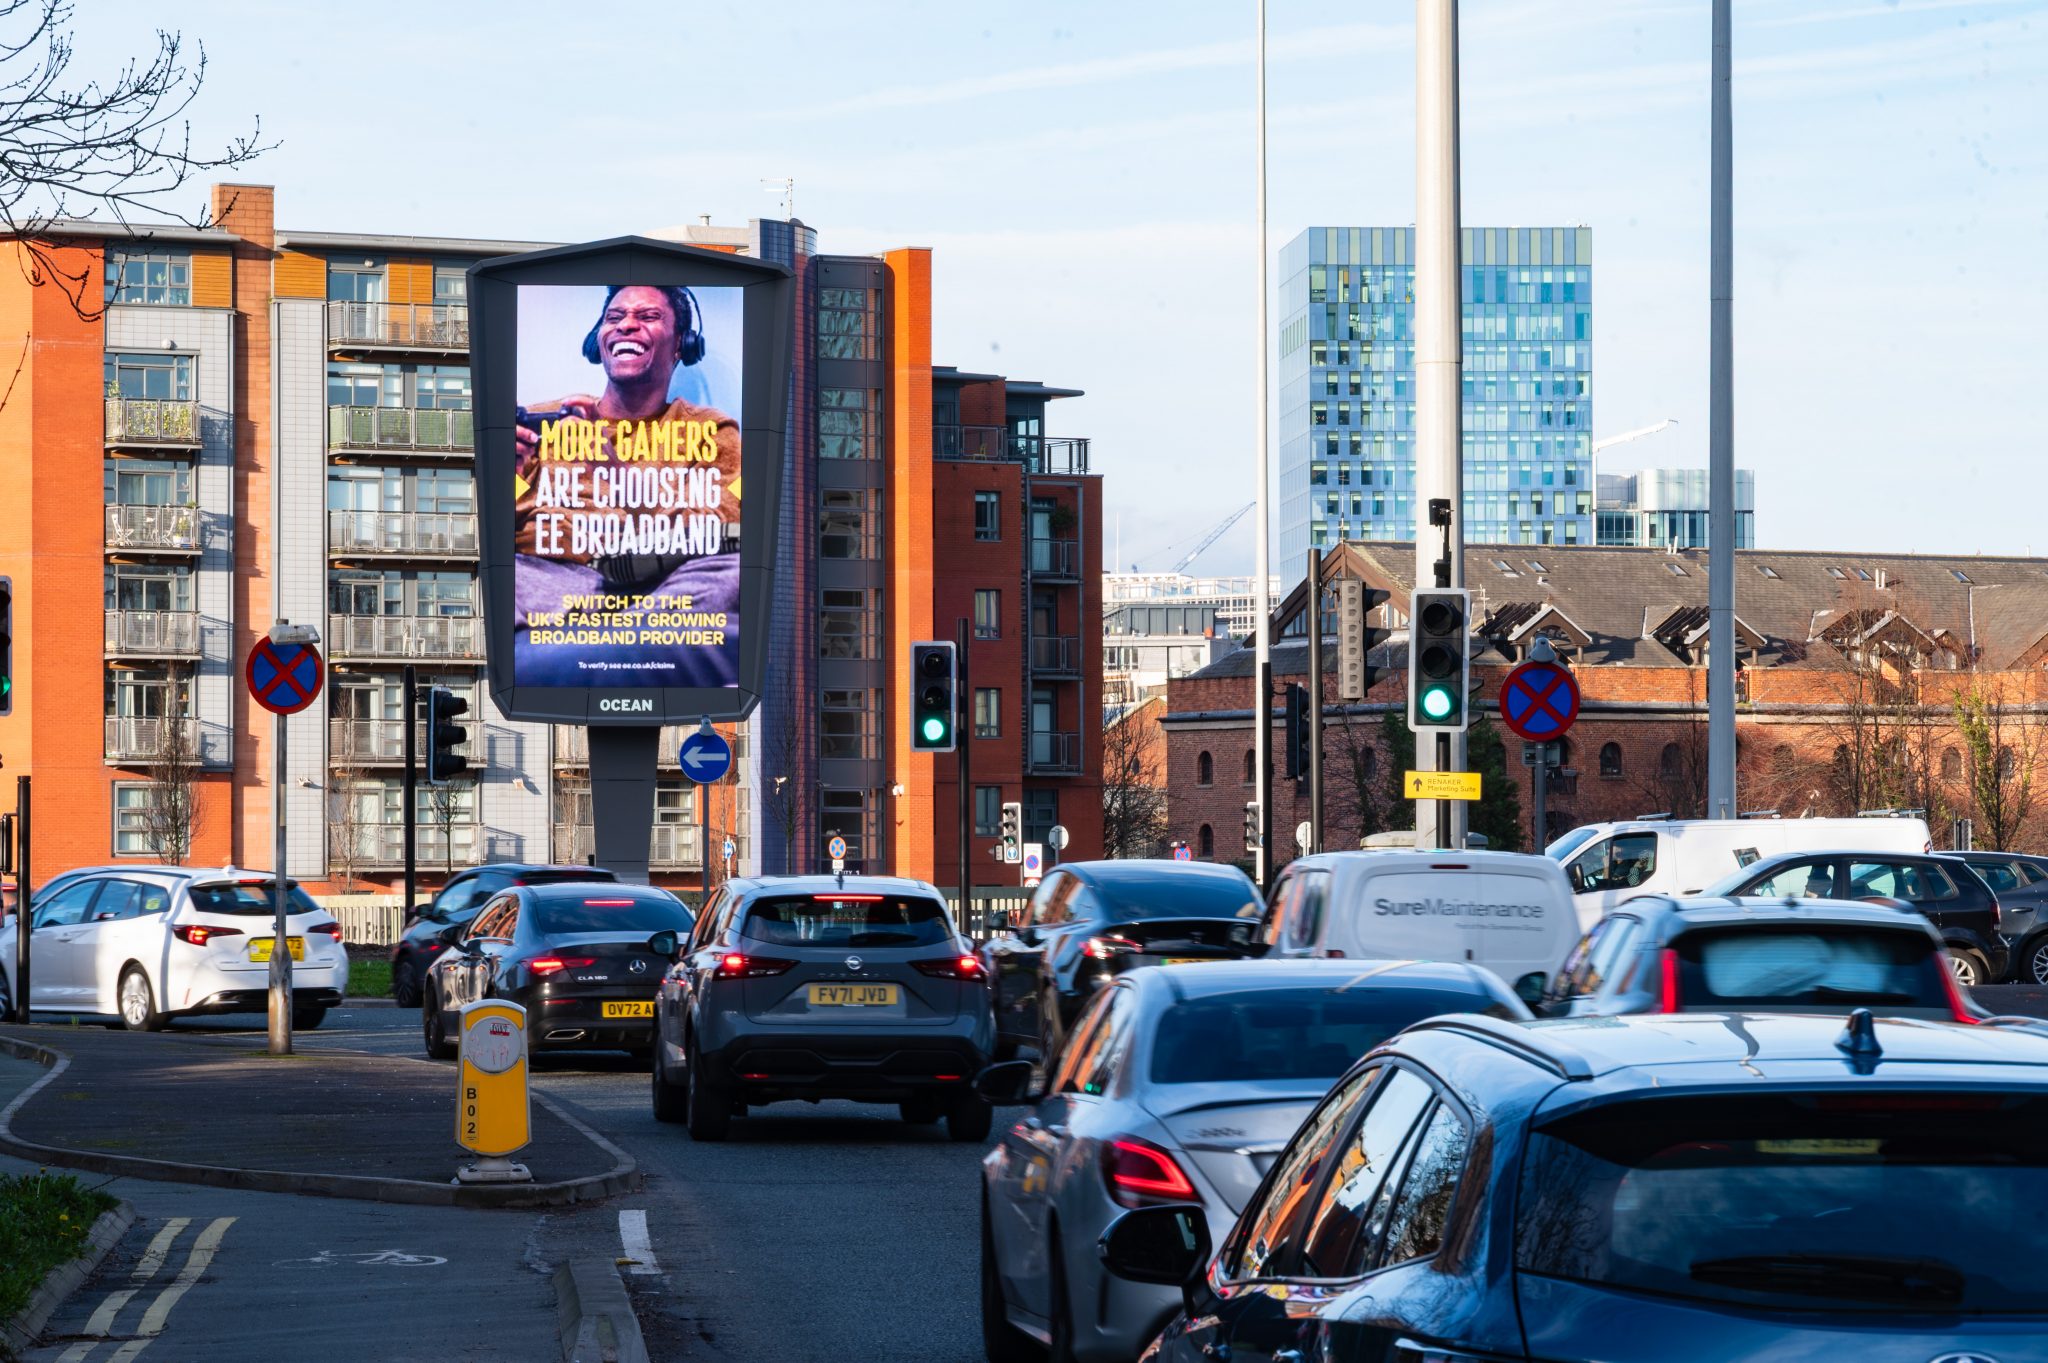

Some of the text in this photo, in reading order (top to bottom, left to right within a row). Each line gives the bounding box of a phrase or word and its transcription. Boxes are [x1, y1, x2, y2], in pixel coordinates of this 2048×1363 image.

[540, 420, 718, 462] MORE GAMERS
[535, 467, 722, 508] ARE CHOOSING
[535, 514, 721, 555] EE BROADBAND
[562, 595, 693, 610] SWITCH TO THE
[527, 612, 727, 627] UK'S FASTEST GROWING
[530, 630, 725, 645] BROADBAND PROVIDER
[588, 662, 607, 670] verify
[599, 699, 653, 711] OCEAN
[1374, 898, 1544, 918] SureMaintenance
[818, 987, 887, 1002] FV71 JVD
[608, 1004, 652, 1015] OV72 A
